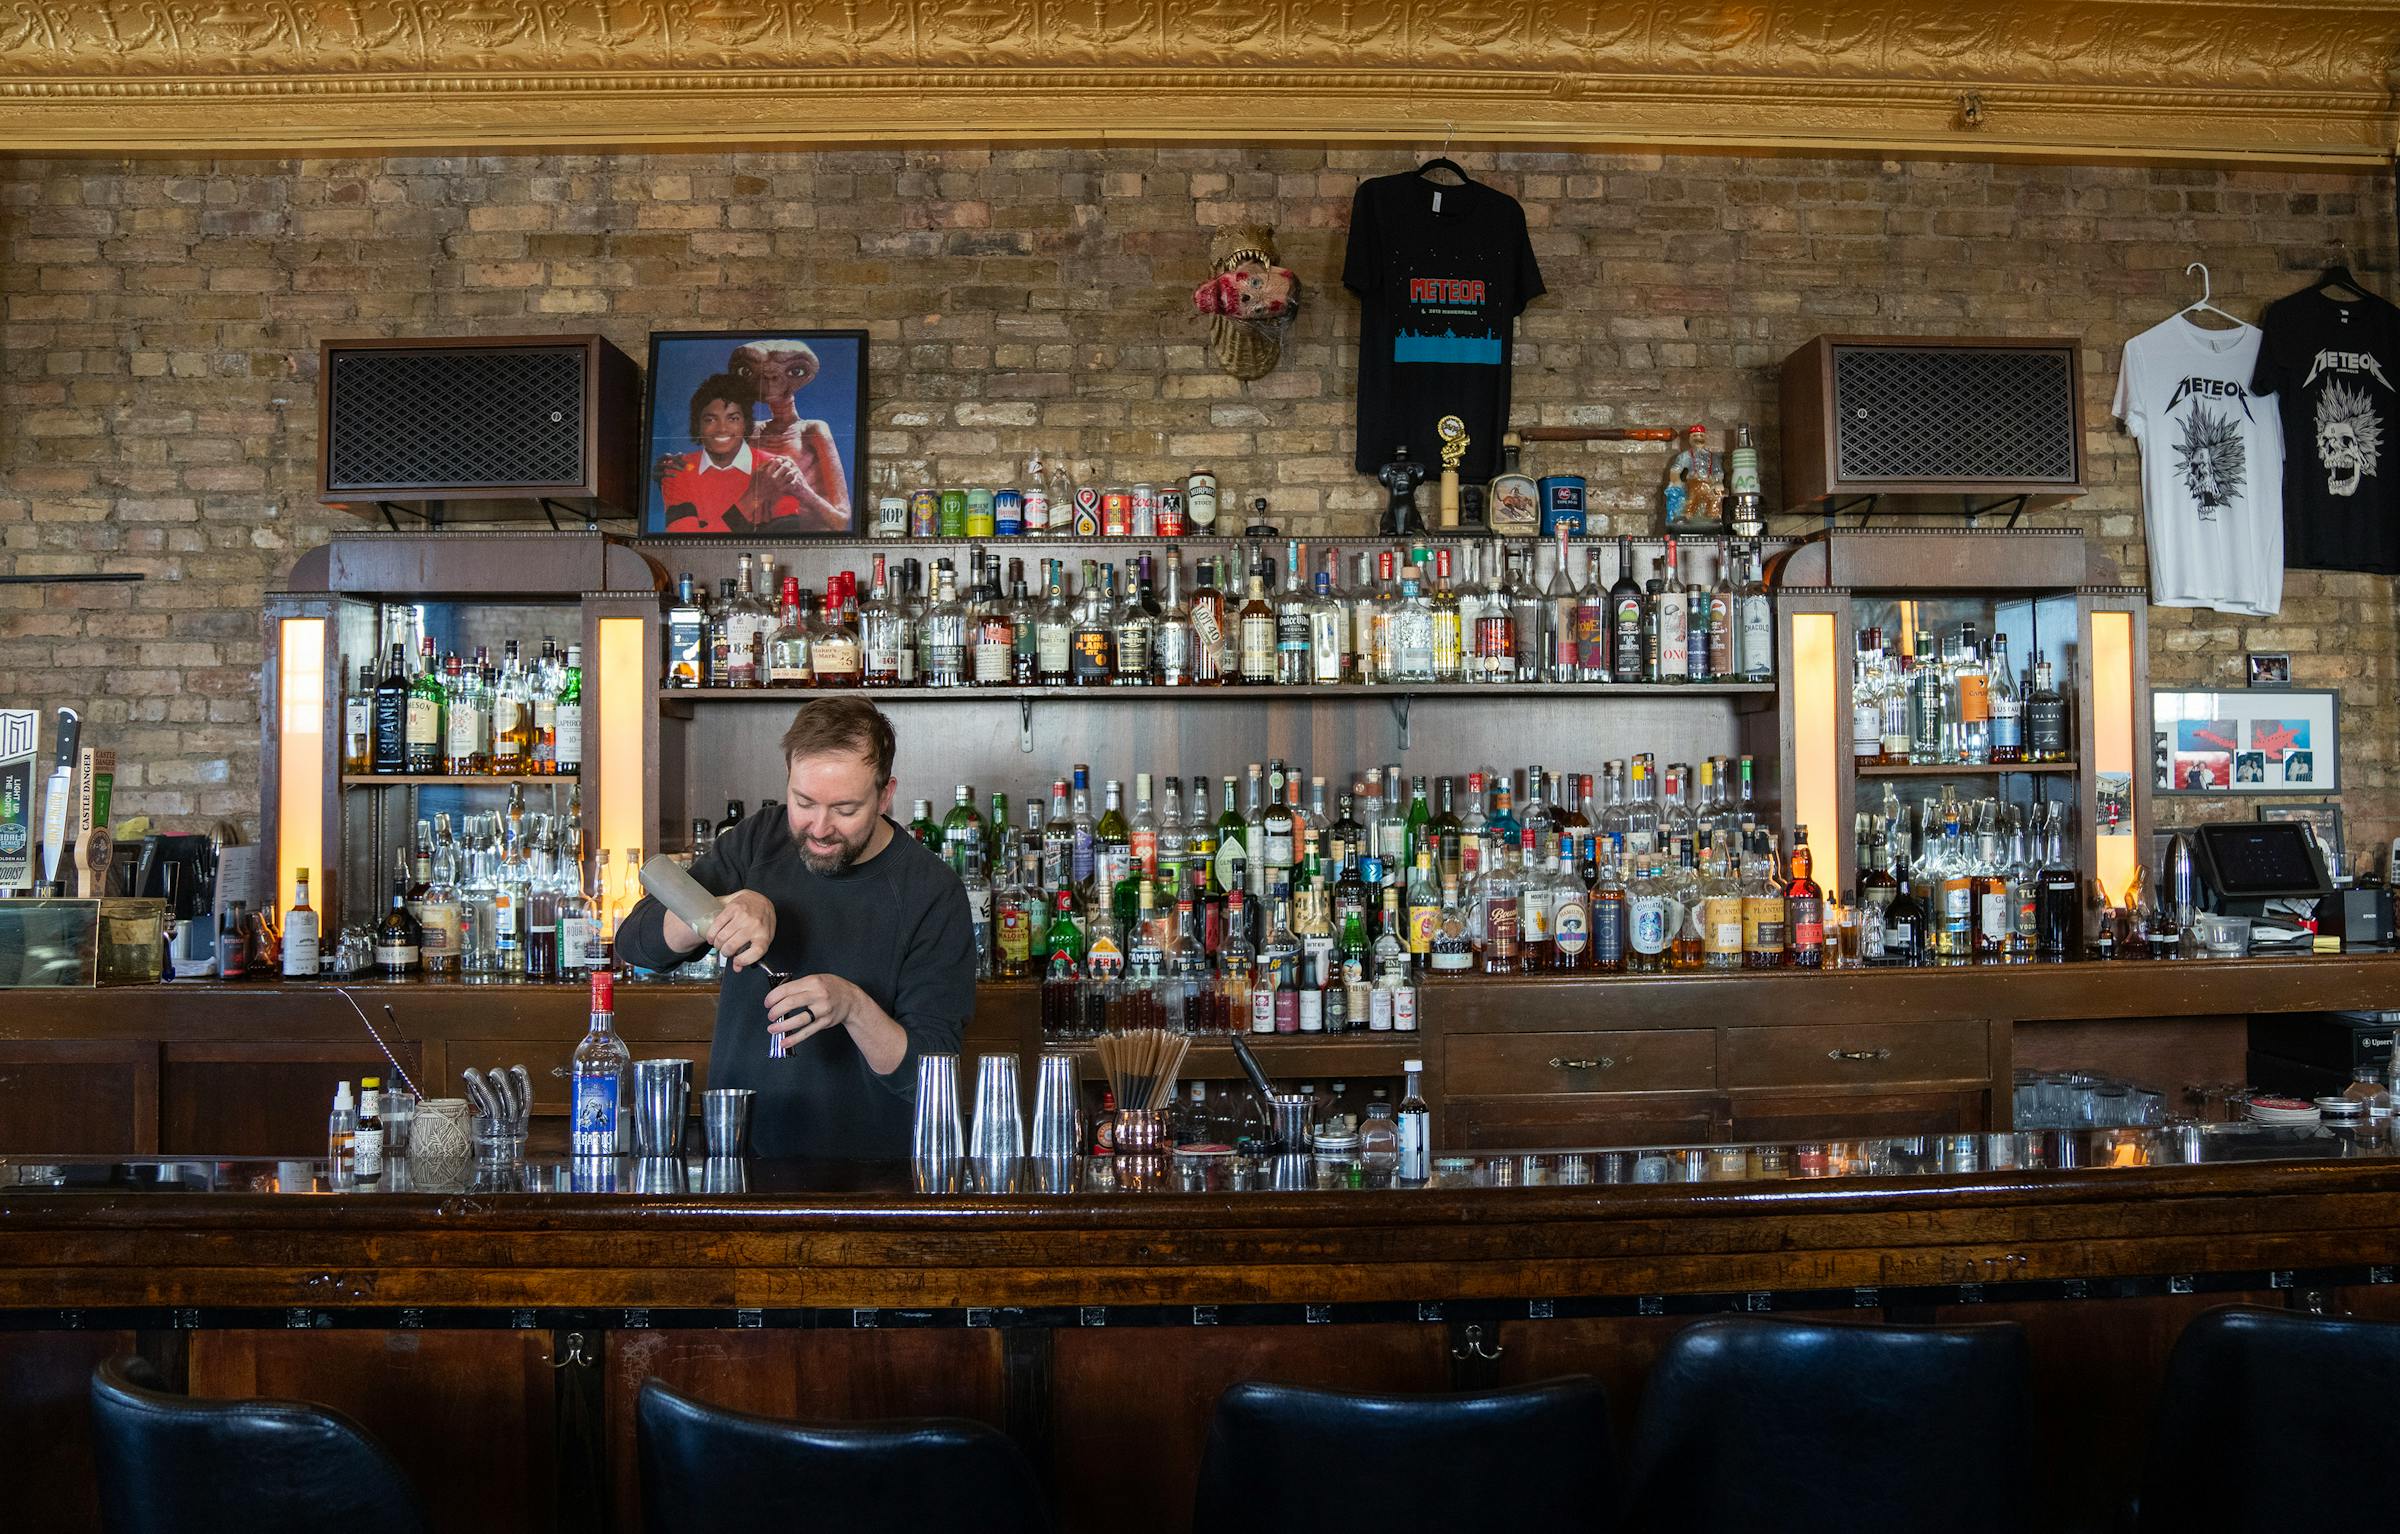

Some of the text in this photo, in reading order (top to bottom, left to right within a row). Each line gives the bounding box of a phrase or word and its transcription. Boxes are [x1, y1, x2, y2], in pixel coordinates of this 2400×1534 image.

[1410, 278, 1486, 305] METEOR
[2302, 348, 2397, 393] METEOR
[2163, 374, 2257, 425] METEOR
[1083, 520, 1091, 531] S
[1079, 633, 1104, 642] HIGH
[1207, 623, 1220, 642] 40
[933, 646, 965, 656] BAKER'S
[1075, 641, 1109, 650] PLAINS
[4, 775, 13, 818] THE NORTH
[12, 779, 22, 814] LIGHT UP
[82, 753, 92, 831] CASTLE DANGER
[2371, 1038, 2395, 1048] Upserv
